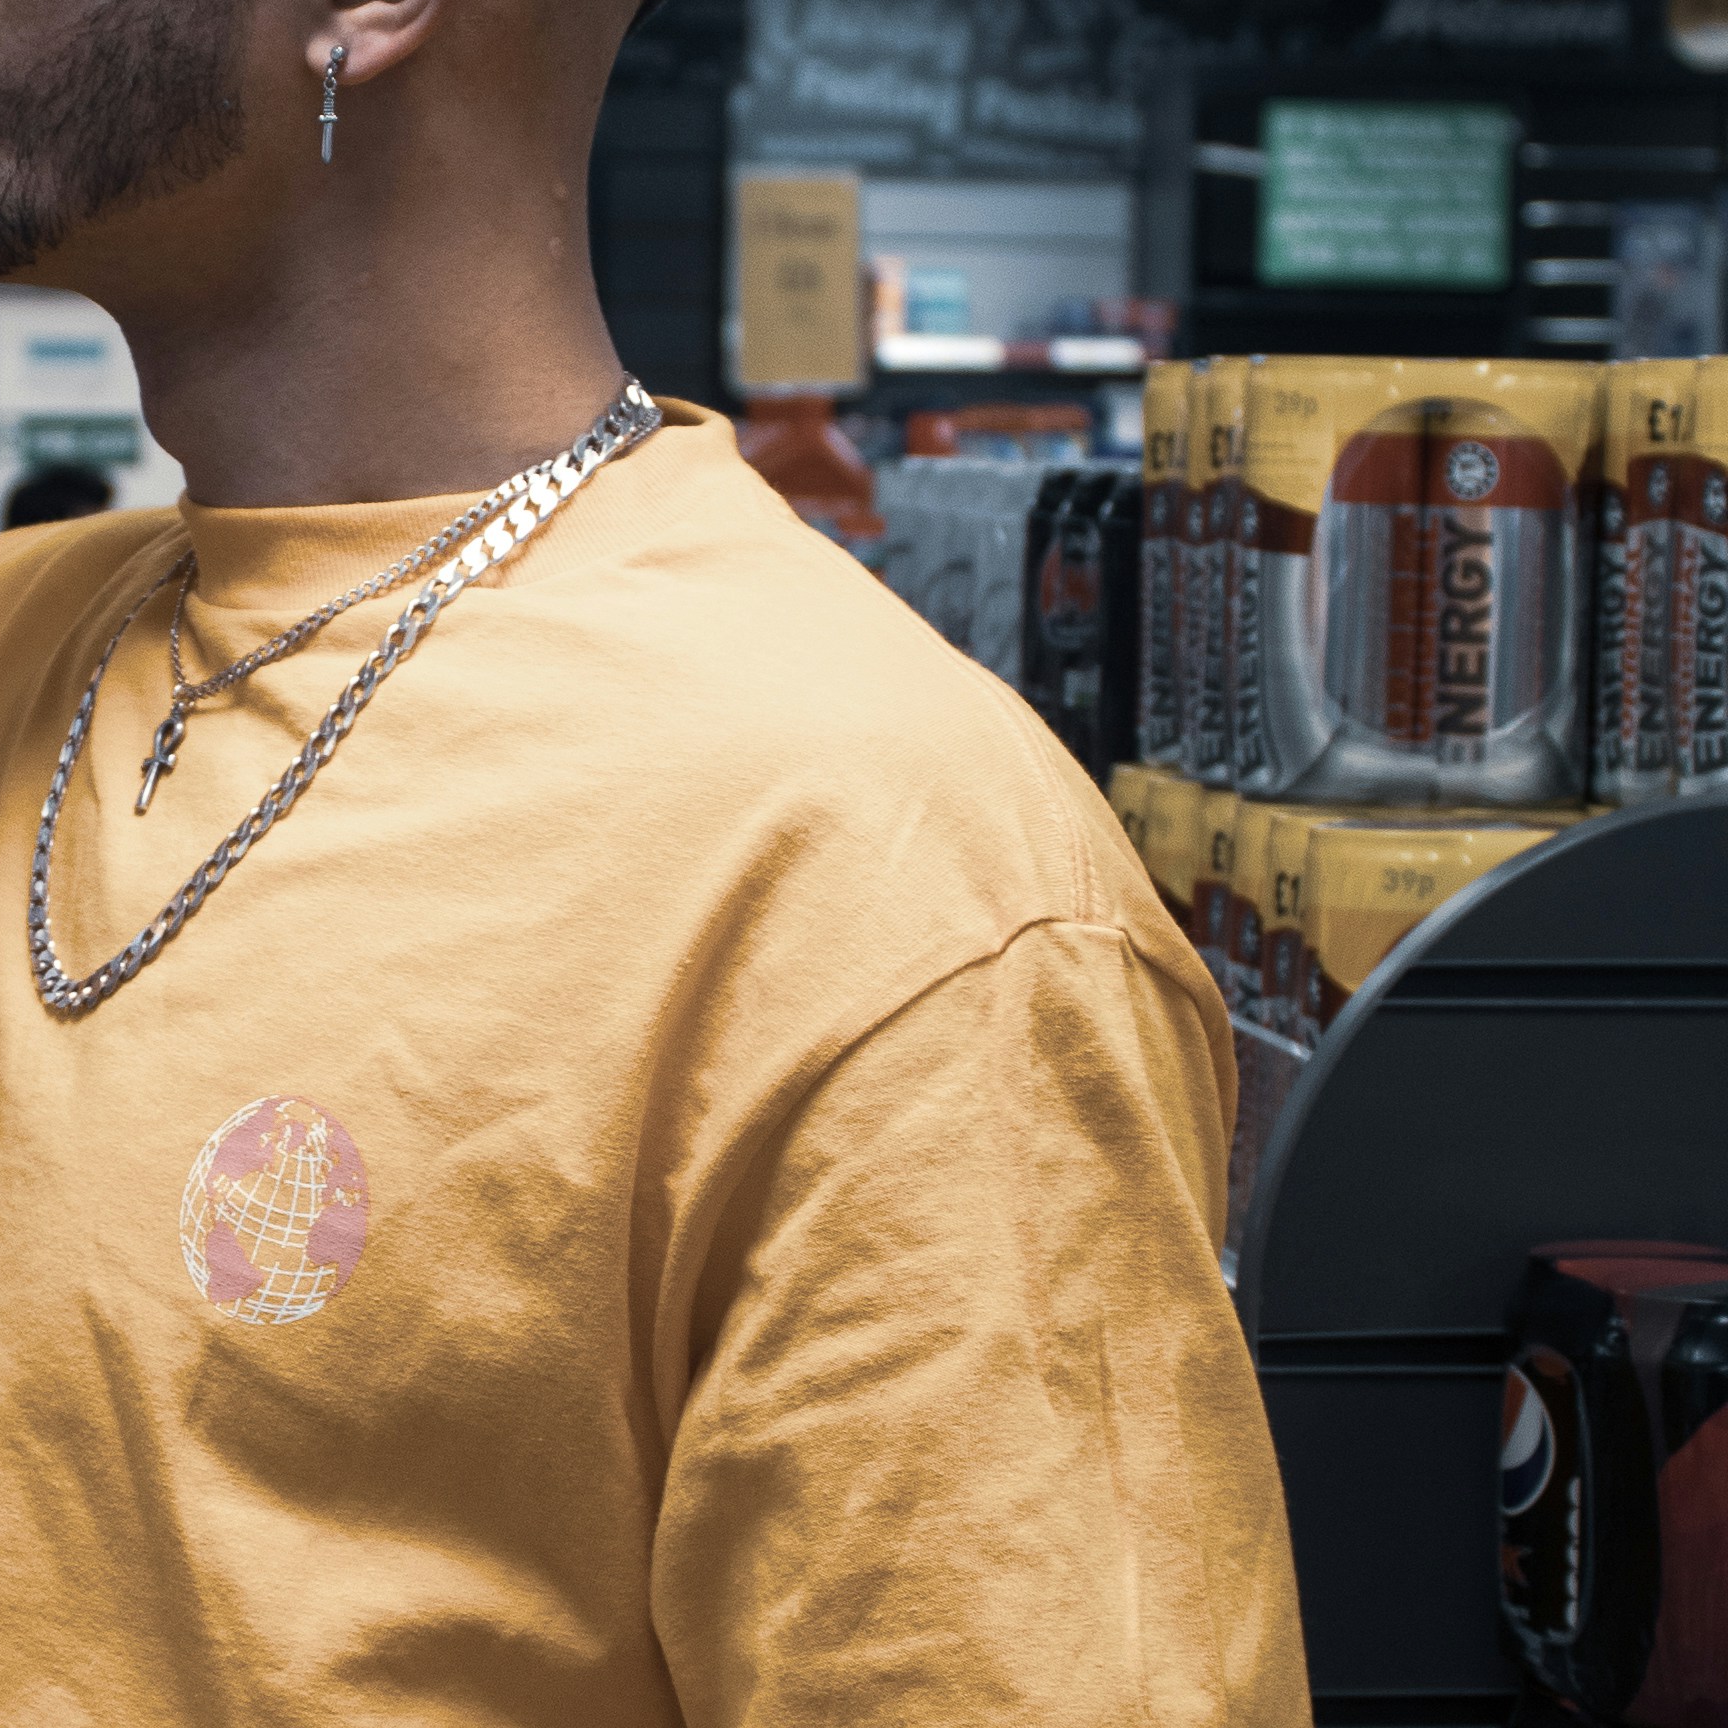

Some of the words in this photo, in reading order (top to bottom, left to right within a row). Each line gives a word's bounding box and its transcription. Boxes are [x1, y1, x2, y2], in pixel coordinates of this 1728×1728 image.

[1435, 511, 1494, 766] ENERGY
[1694, 539, 1728, 775] ENERGY
[1382, 867, 1436, 899] 39p
